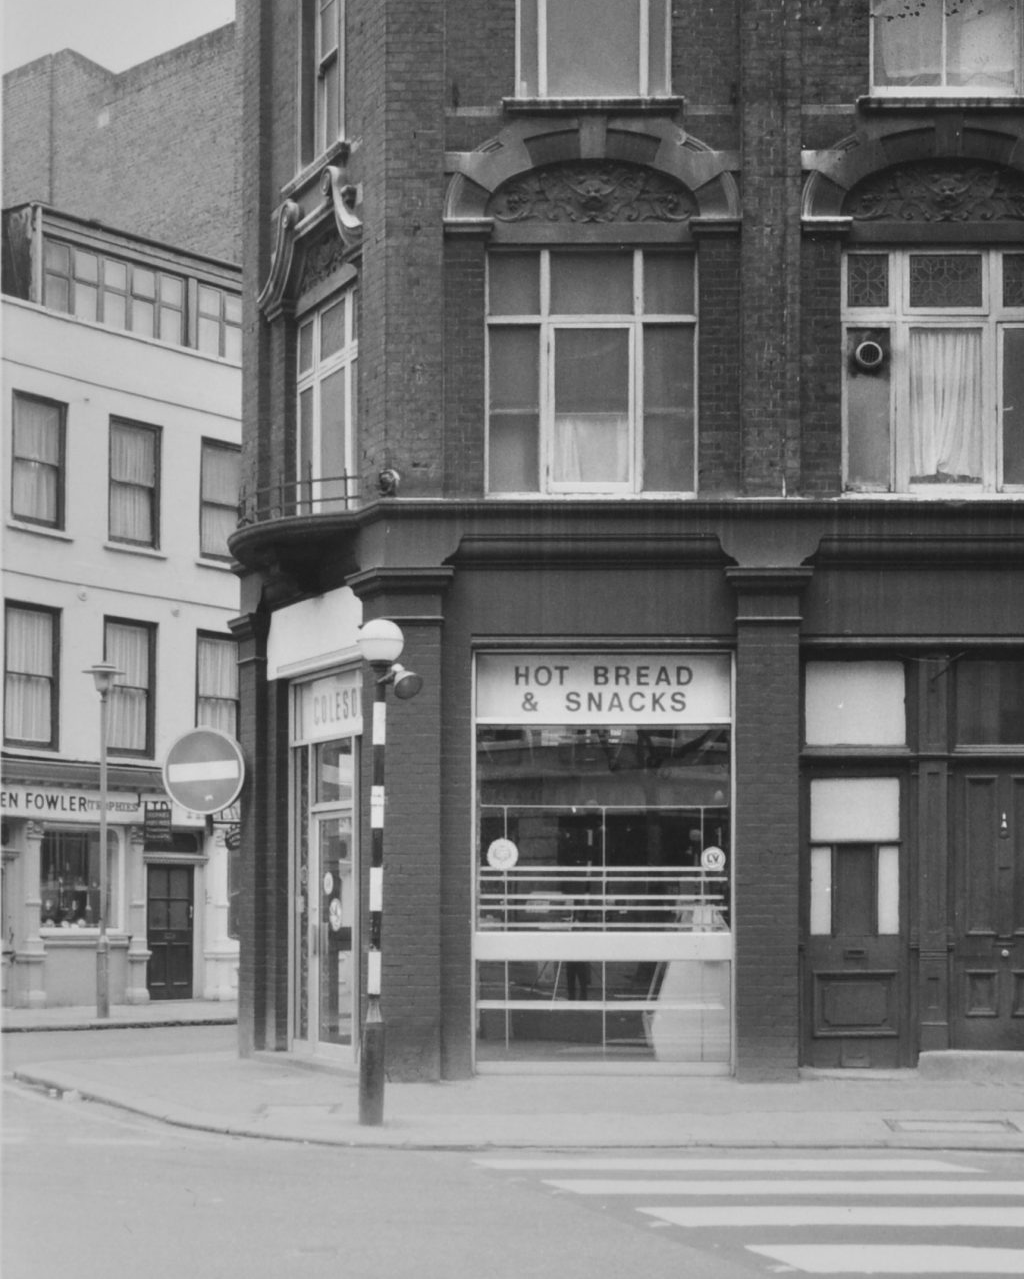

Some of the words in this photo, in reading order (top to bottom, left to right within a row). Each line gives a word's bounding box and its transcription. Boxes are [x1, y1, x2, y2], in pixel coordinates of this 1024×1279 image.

[514, 666, 569, 686] HOT
[593, 666, 694, 686] BREAD
[521, 692, 538, 712] &
[565, 692, 687, 712] SNACKS
[26, 793, 88, 812] FOWLER
